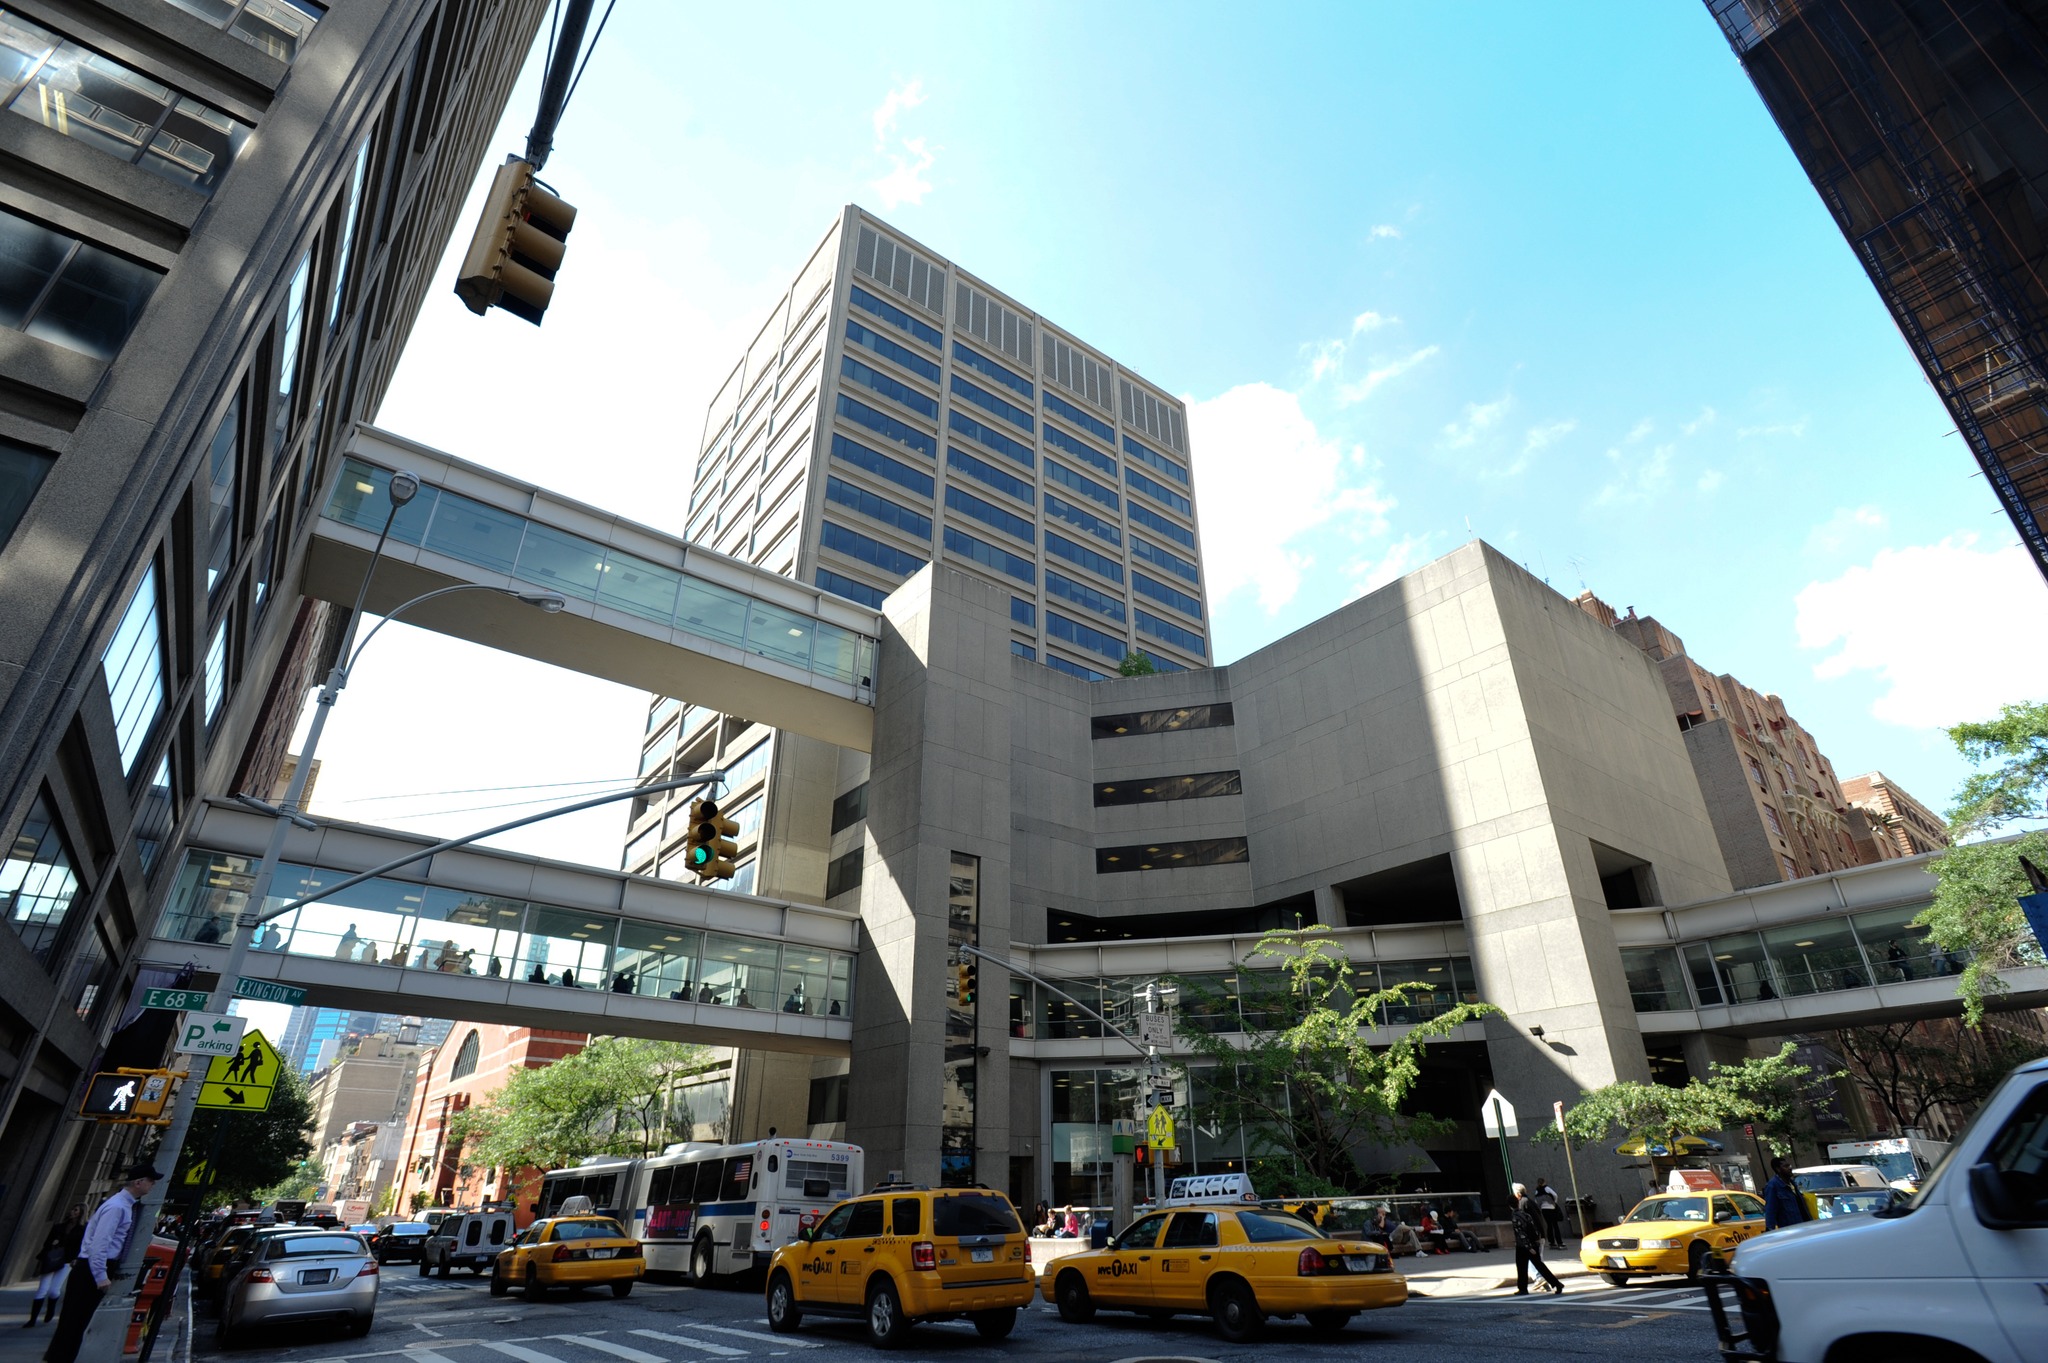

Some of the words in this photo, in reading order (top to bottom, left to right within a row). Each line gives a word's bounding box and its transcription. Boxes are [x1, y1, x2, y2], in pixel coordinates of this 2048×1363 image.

[147, 990, 159, 1006] E
[165, 993, 187, 1008] 68
[193, 994, 204, 1003] ST
[235, 979, 289, 1001] LEXINGTON
[291, 990, 302, 998] AV
[1145, 1014, 1165, 1023] BUSES
[183, 1025, 233, 1053] Parking
[1148, 1026, 1163, 1034] ONLY
[831, 1153, 849, 1161] 5399
[1097, 1266, 1112, 1275] NYC
[1112, 1259, 1137, 1277] TAXI
